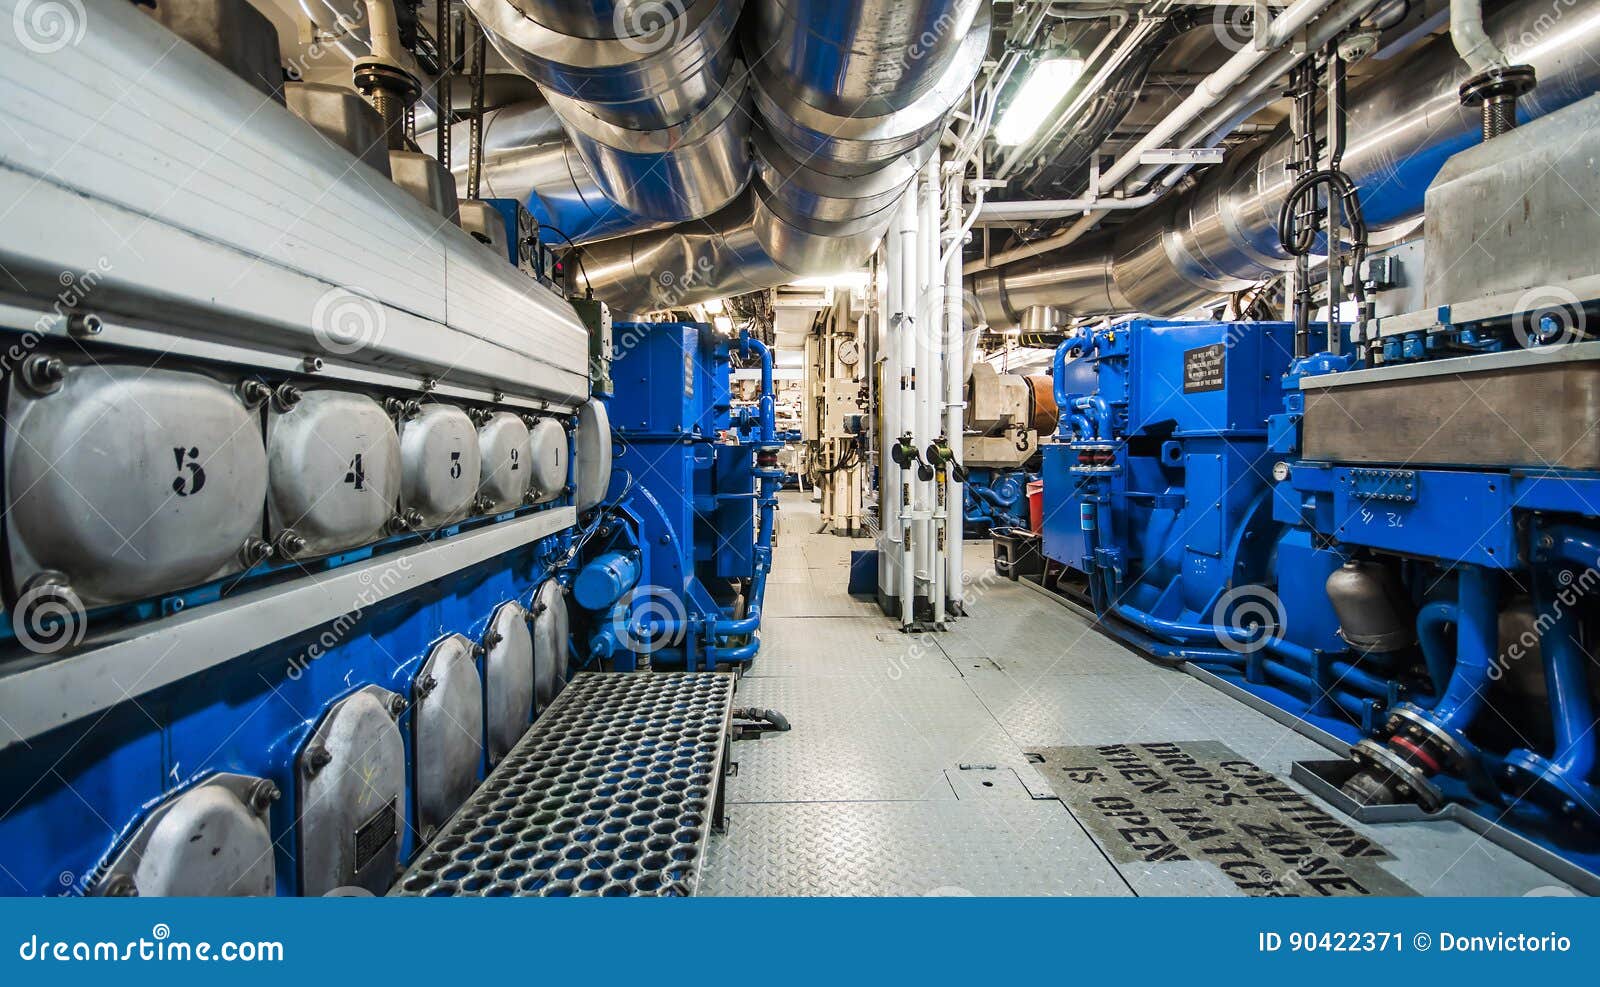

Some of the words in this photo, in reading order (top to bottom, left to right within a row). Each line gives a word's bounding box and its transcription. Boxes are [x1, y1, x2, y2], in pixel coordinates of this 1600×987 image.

[510, 448, 519, 471] 2
[554, 447, 560, 467] 1
[1016, 430, 1029, 451] 3
[172, 446, 206, 497] 5
[344, 453, 365, 490] 4
[451, 452, 462, 480] 3
[1095, 743, 1181, 794] WHEN
[1062, 766, 1108, 784] IS
[1091, 796, 1192, 862] OPEN
[1140, 742, 1250, 807] DROPS
[1236, 822, 1371, 897] ZONE
[1219, 761, 1388, 858] CAUTION
